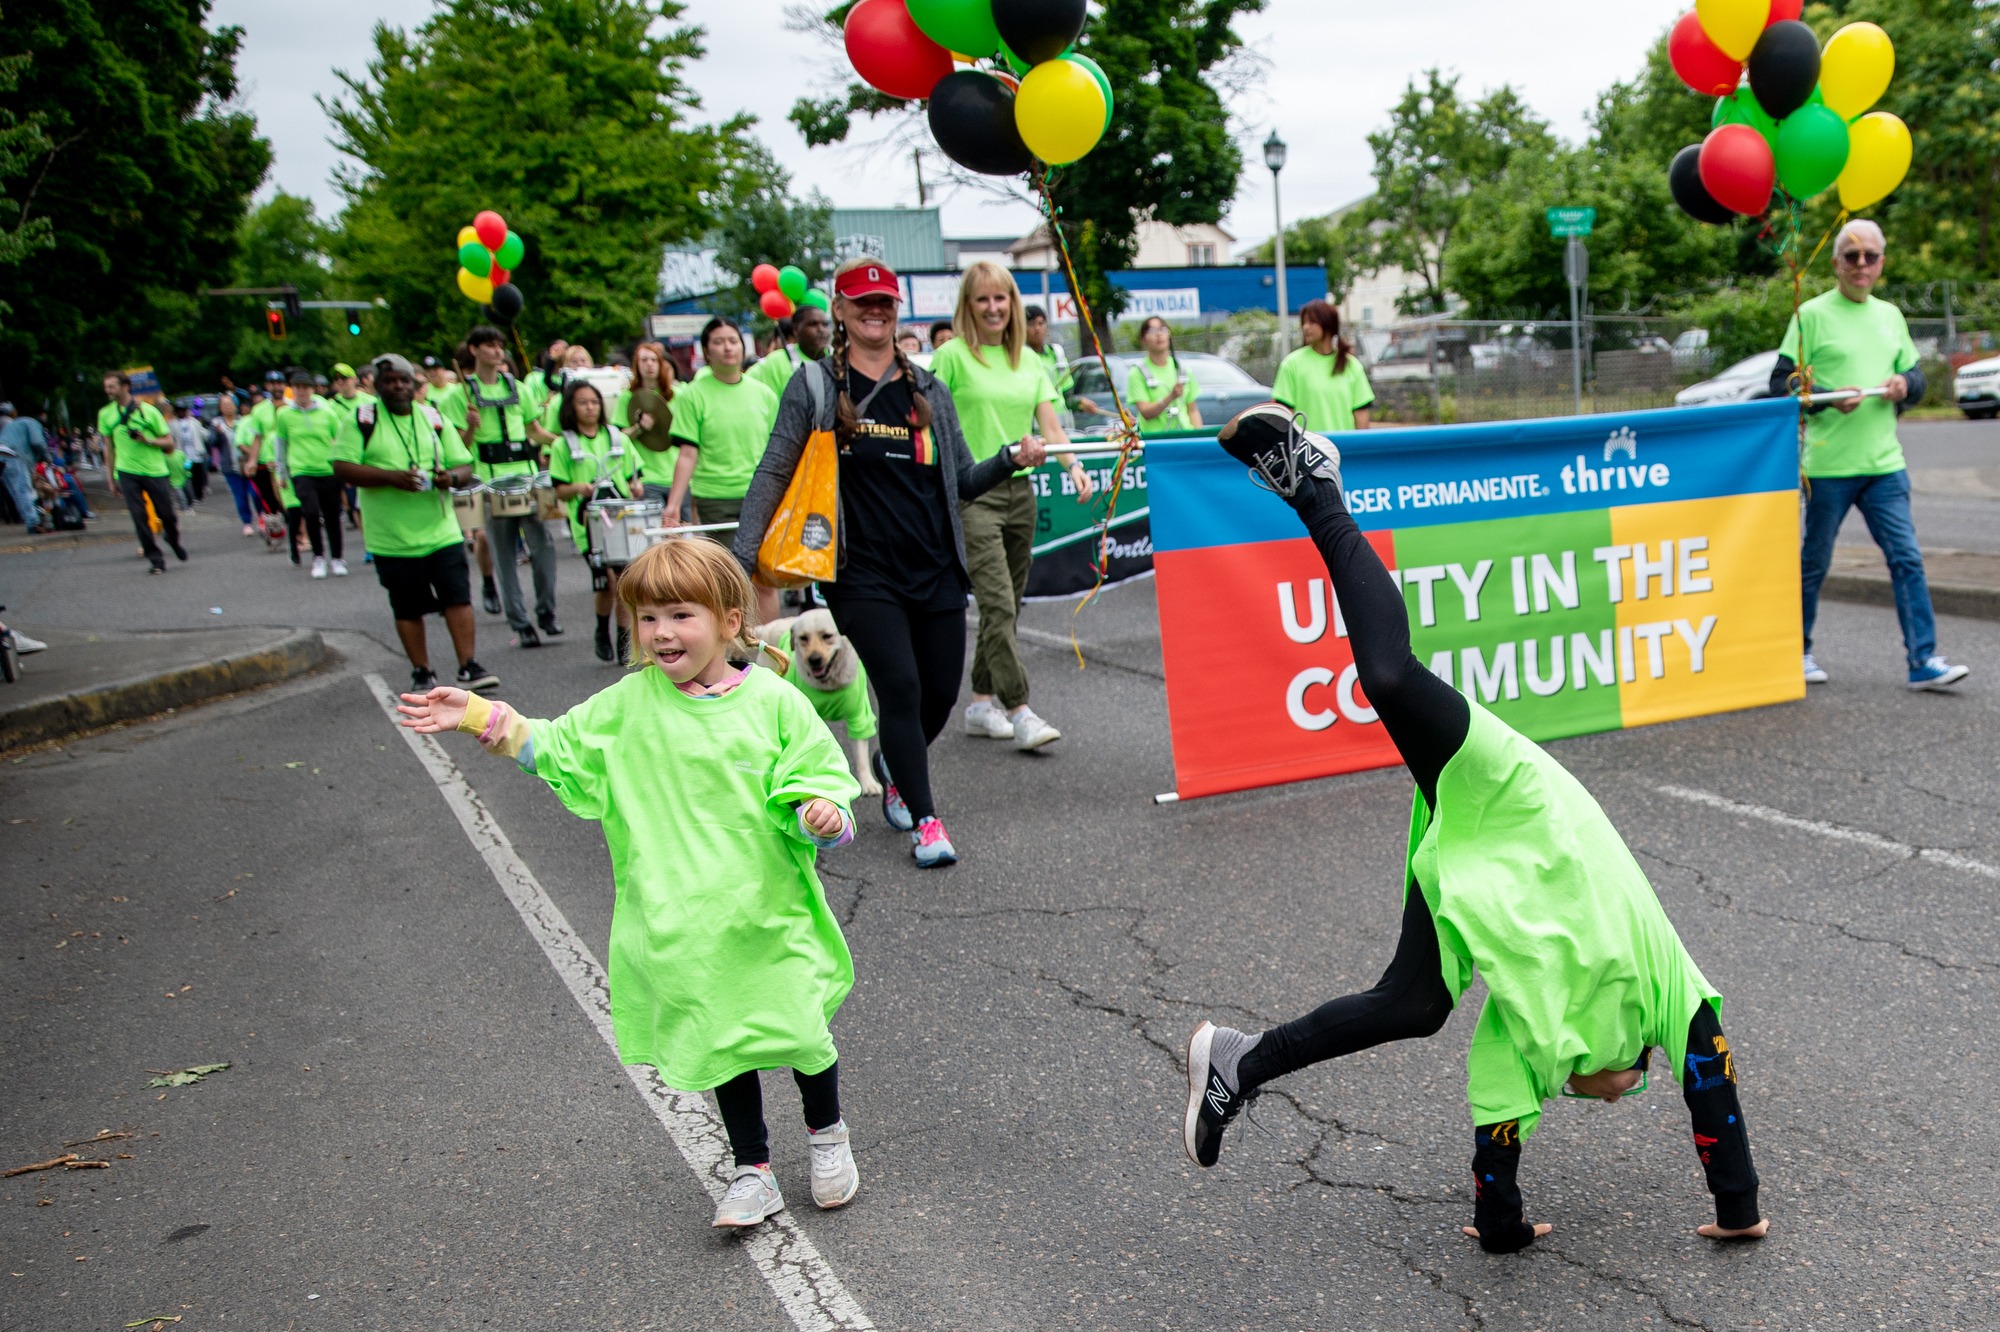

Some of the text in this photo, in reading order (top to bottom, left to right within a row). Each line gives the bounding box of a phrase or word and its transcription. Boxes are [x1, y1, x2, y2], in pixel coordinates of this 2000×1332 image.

[1060, 468, 1114, 496] HGH
[1560, 455, 1671, 495] thrive
[1344, 487, 1392, 514] ISER
[1277, 536, 1714, 644] UTY IN THE
